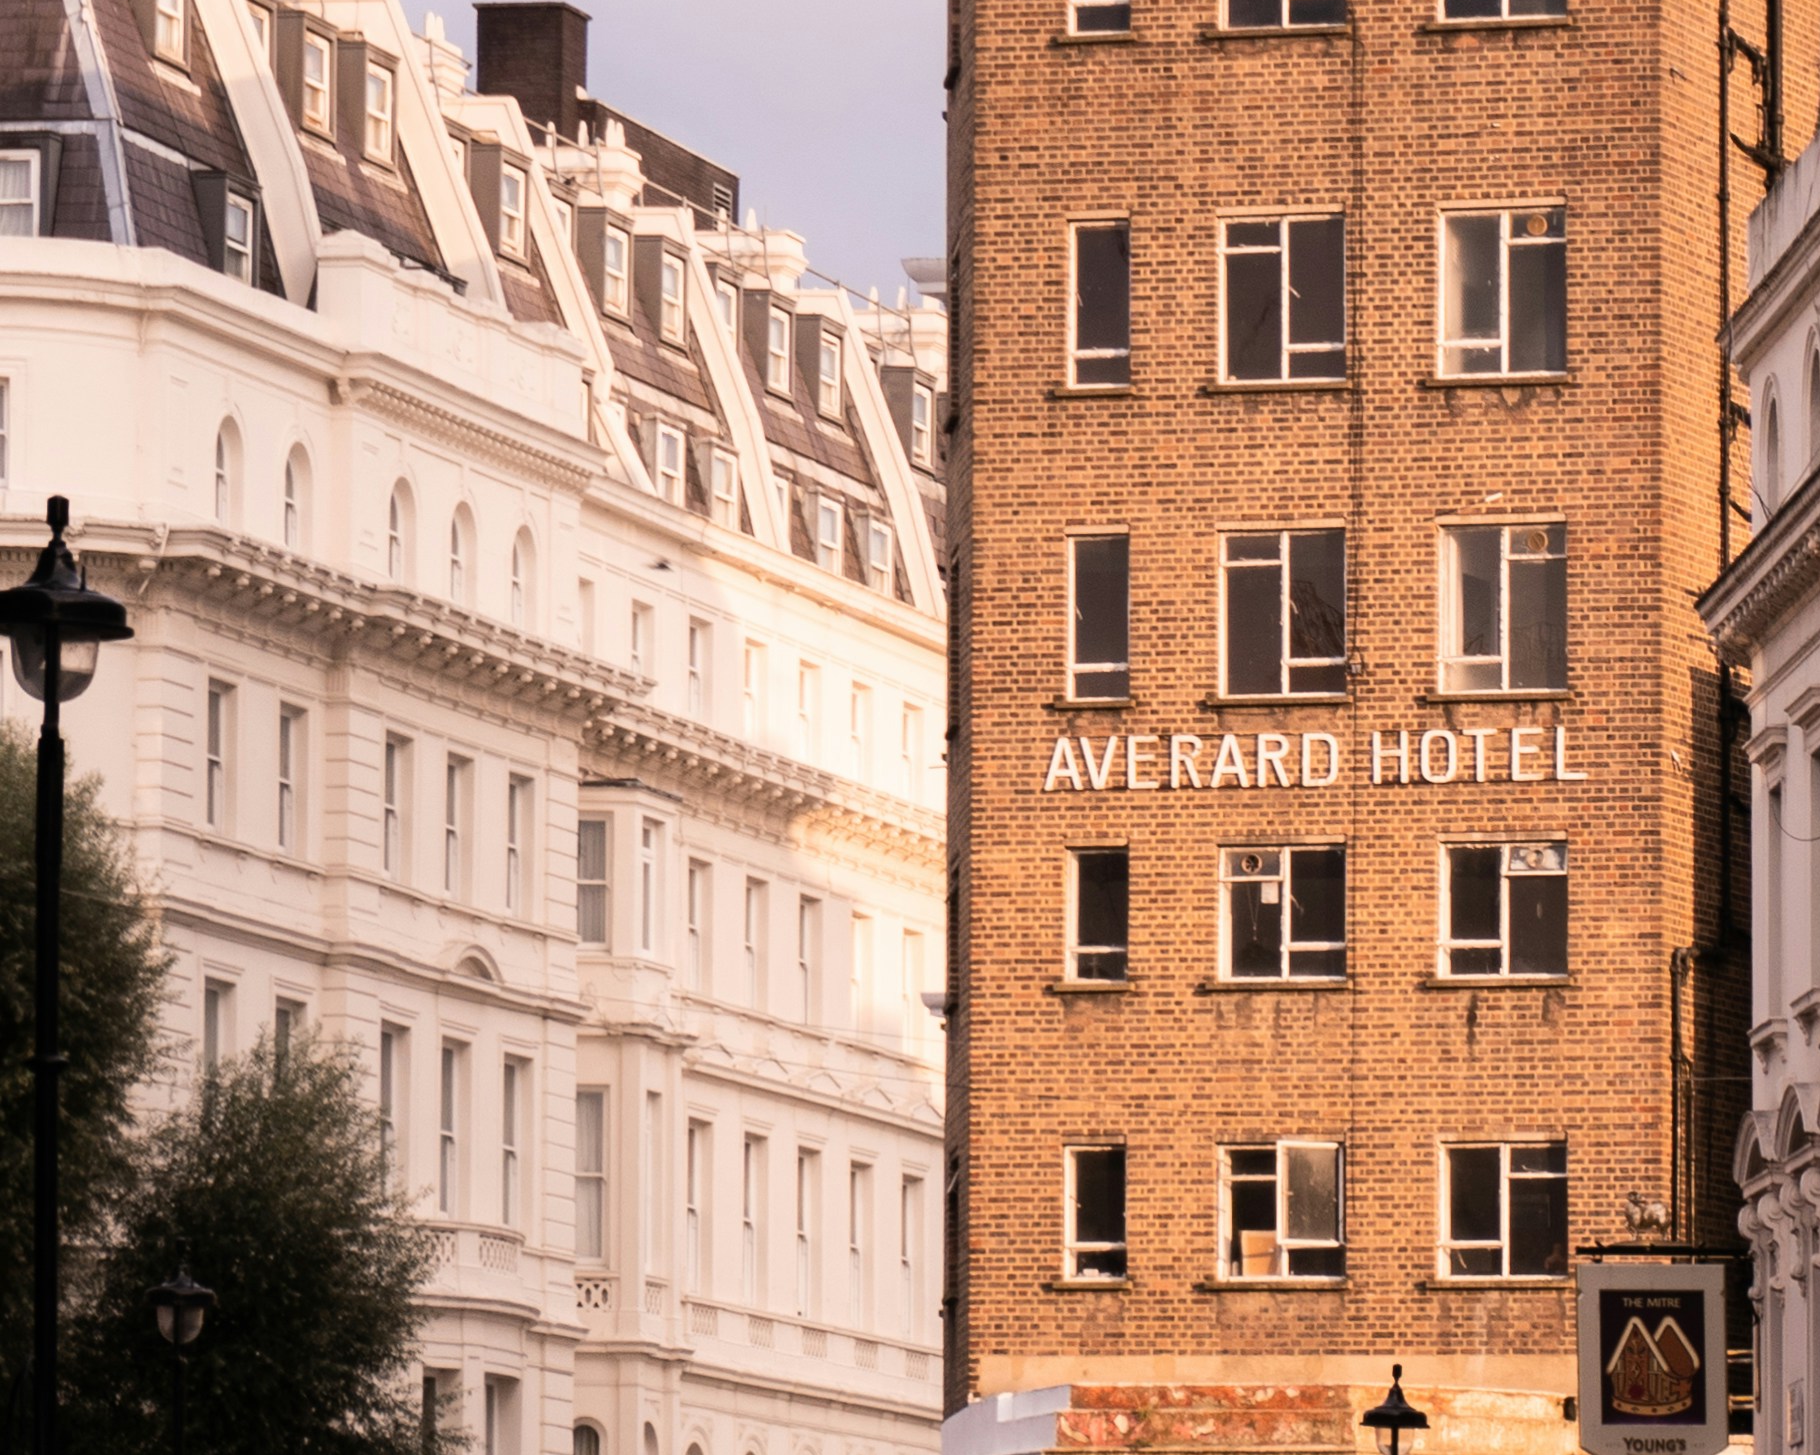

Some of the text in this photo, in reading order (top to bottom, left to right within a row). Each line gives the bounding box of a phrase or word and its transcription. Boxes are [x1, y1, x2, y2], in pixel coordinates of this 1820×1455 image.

[1043, 725, 1589, 792] AVERARD HOTEL
[1622, 1297, 1681, 1309] THE MITRE
[1622, 1436, 1687, 1453] YOUNG'S
